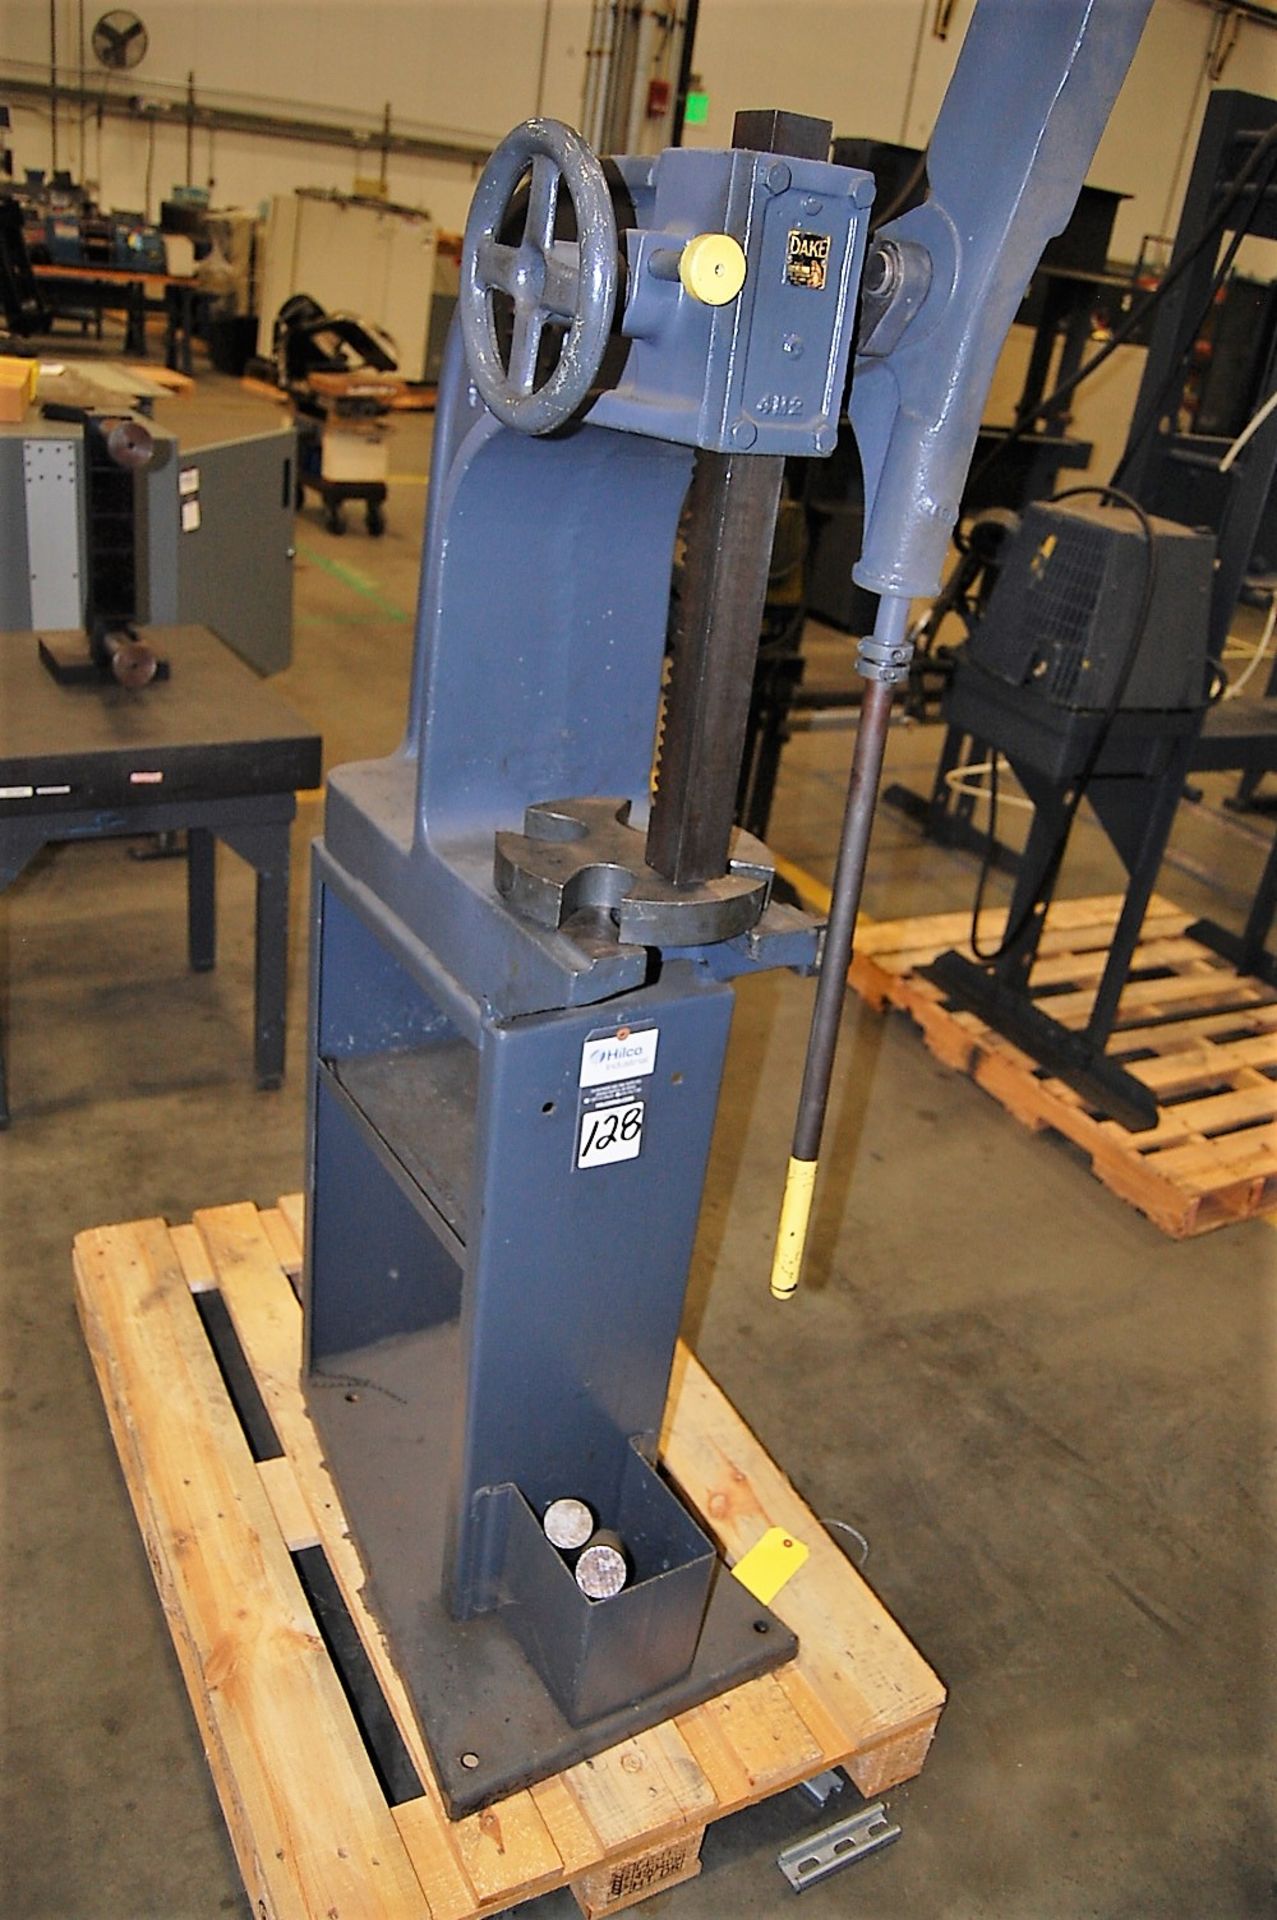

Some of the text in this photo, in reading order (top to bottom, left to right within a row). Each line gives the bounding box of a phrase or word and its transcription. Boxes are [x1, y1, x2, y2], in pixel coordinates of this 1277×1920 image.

[790, 235, 828, 258] DAKE
[607, 1046, 643, 1061] Hilco
[581, 1107, 642, 1158] 128
